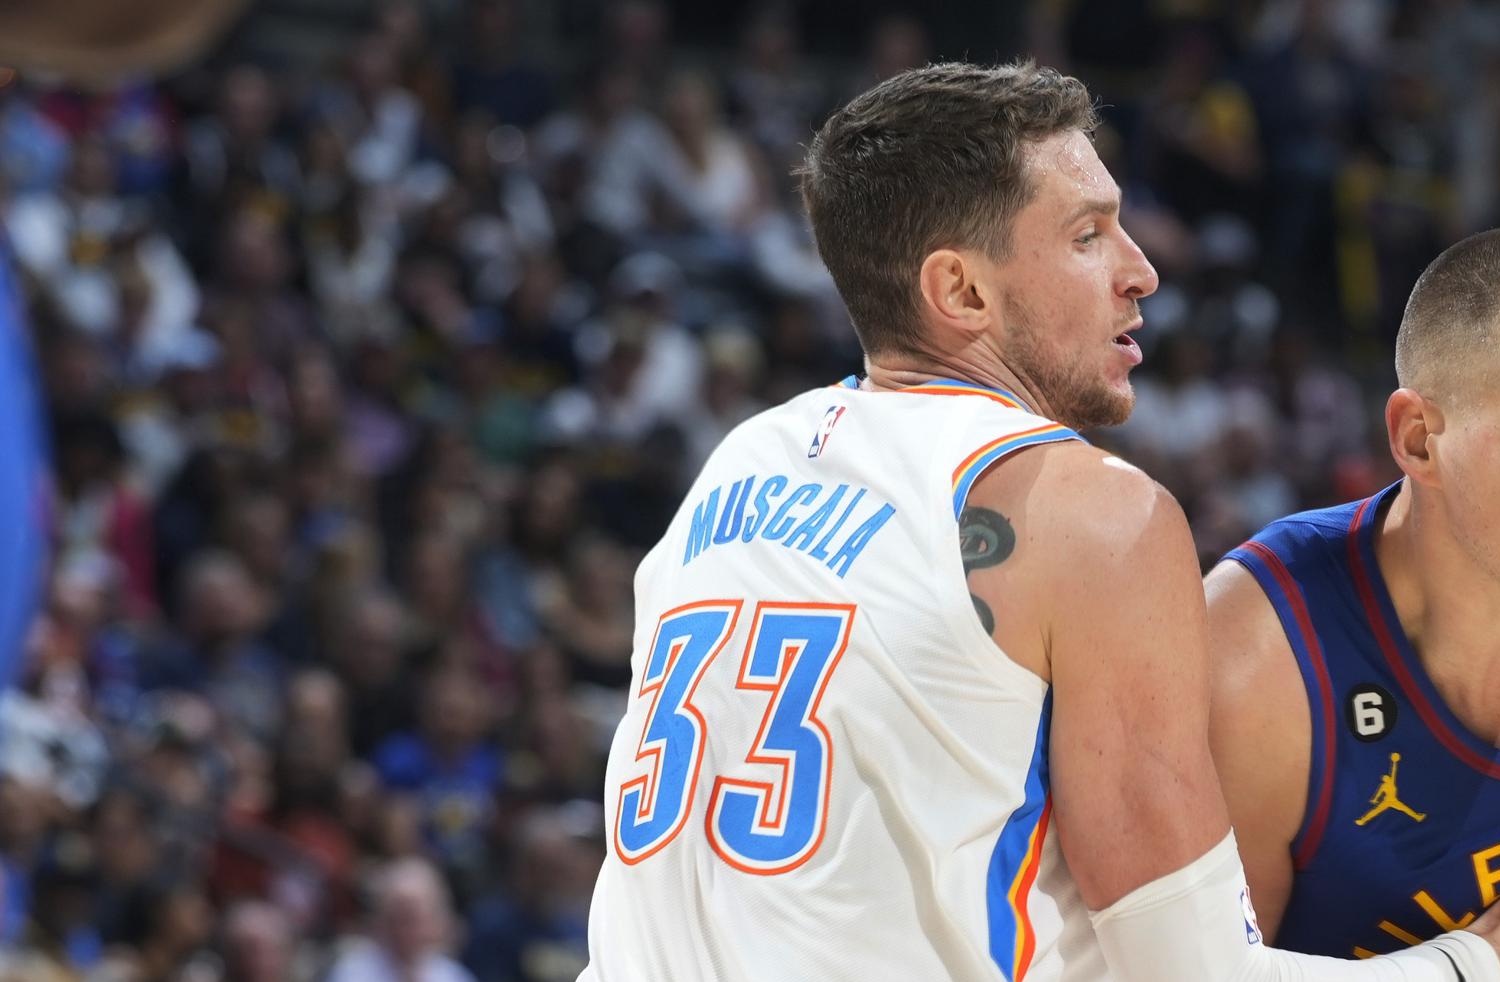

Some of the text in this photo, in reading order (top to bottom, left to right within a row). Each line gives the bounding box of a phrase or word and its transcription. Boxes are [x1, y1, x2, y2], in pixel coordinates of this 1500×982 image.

[683, 474, 896, 579] MUSCALA
[614, 598, 857, 876] 33
[1353, 692, 1385, 736] 6
